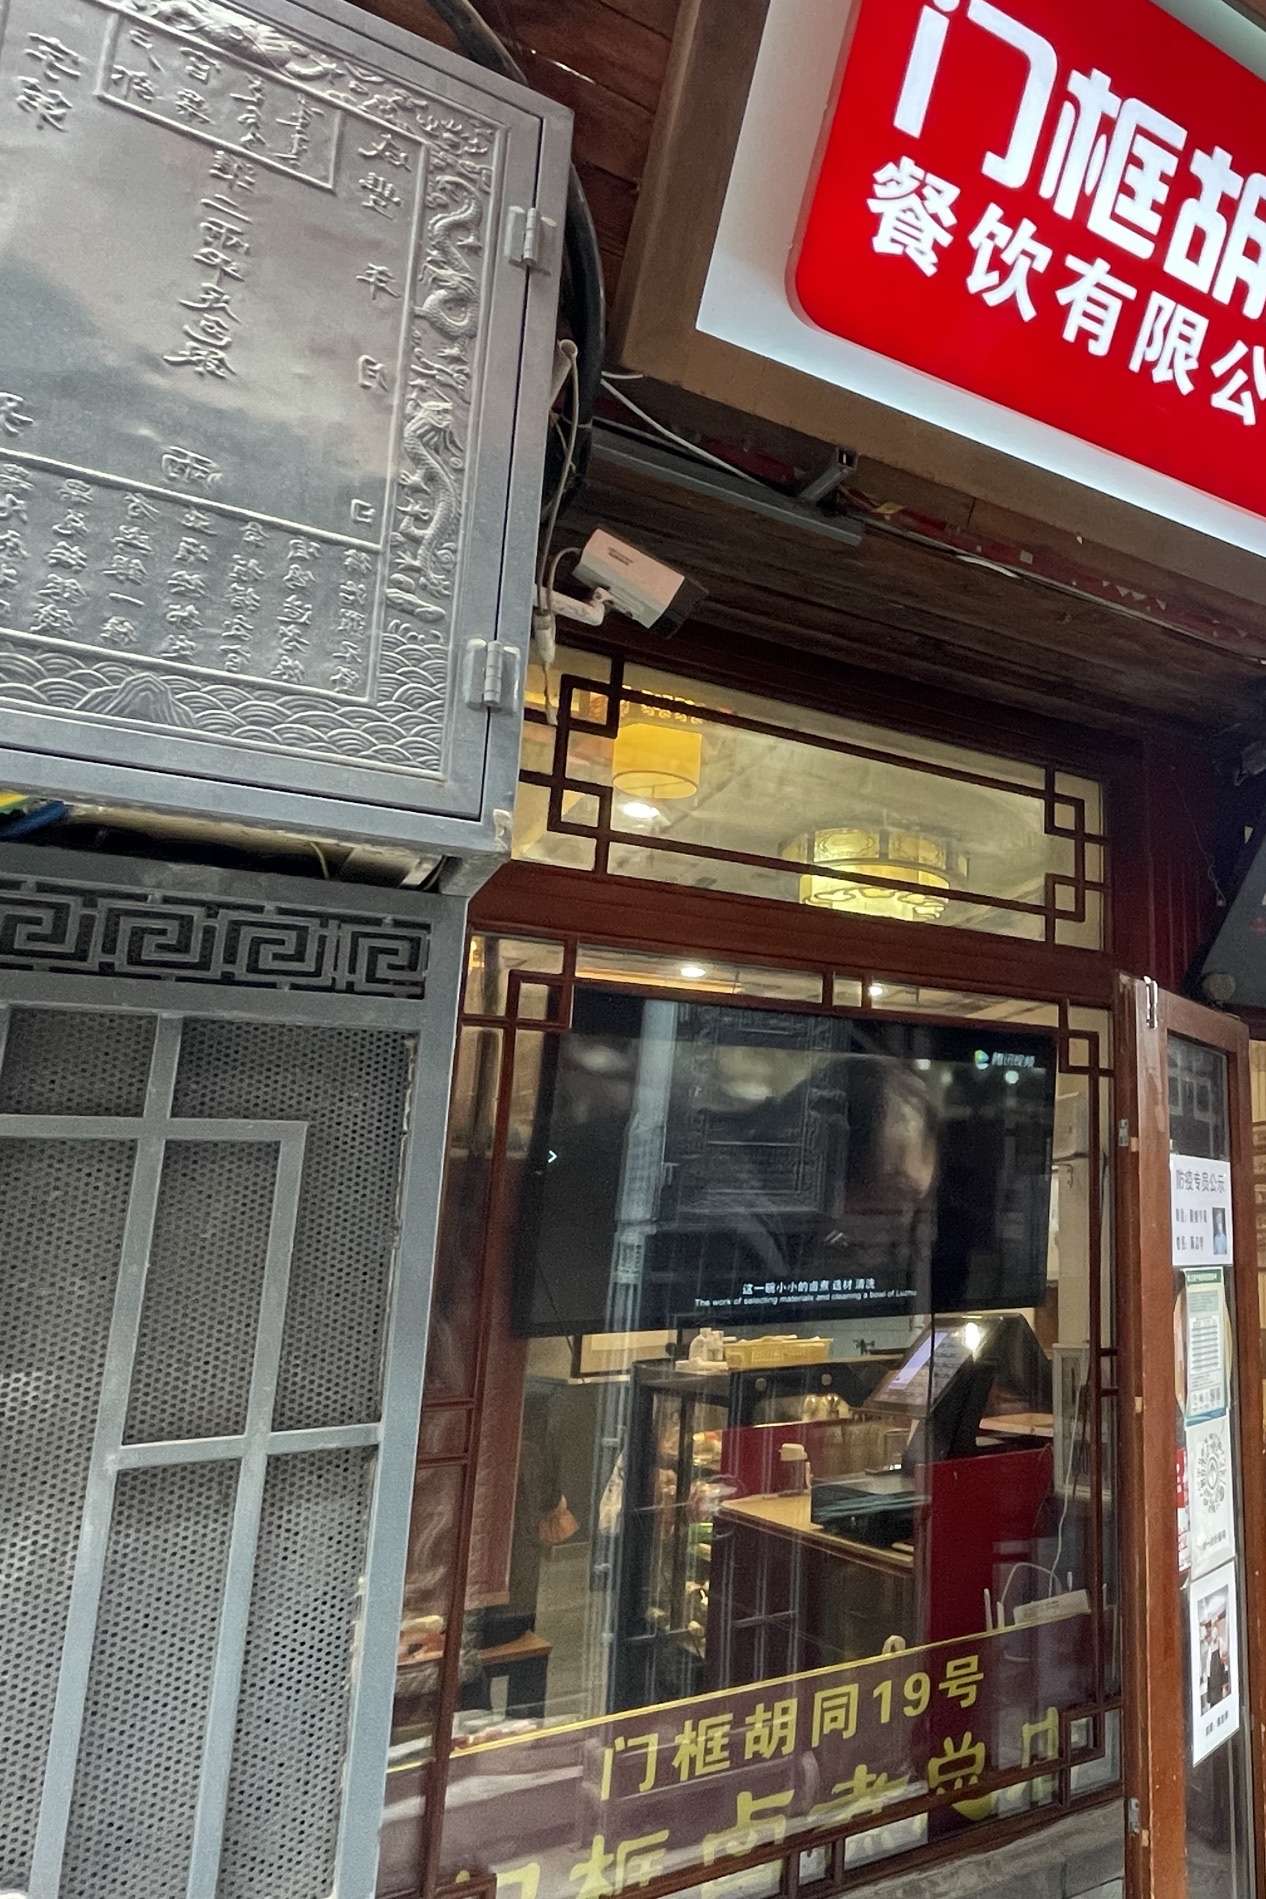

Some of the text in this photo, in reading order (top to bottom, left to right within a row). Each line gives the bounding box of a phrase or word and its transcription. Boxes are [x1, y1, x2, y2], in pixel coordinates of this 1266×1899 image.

[743, 1296, 778, 1306] selecting
[779, 1294, 814, 1303] materials
[831, 1292, 862, 1301] cleaning
[601, 1655, 986, 1801] 门框胡同19号
